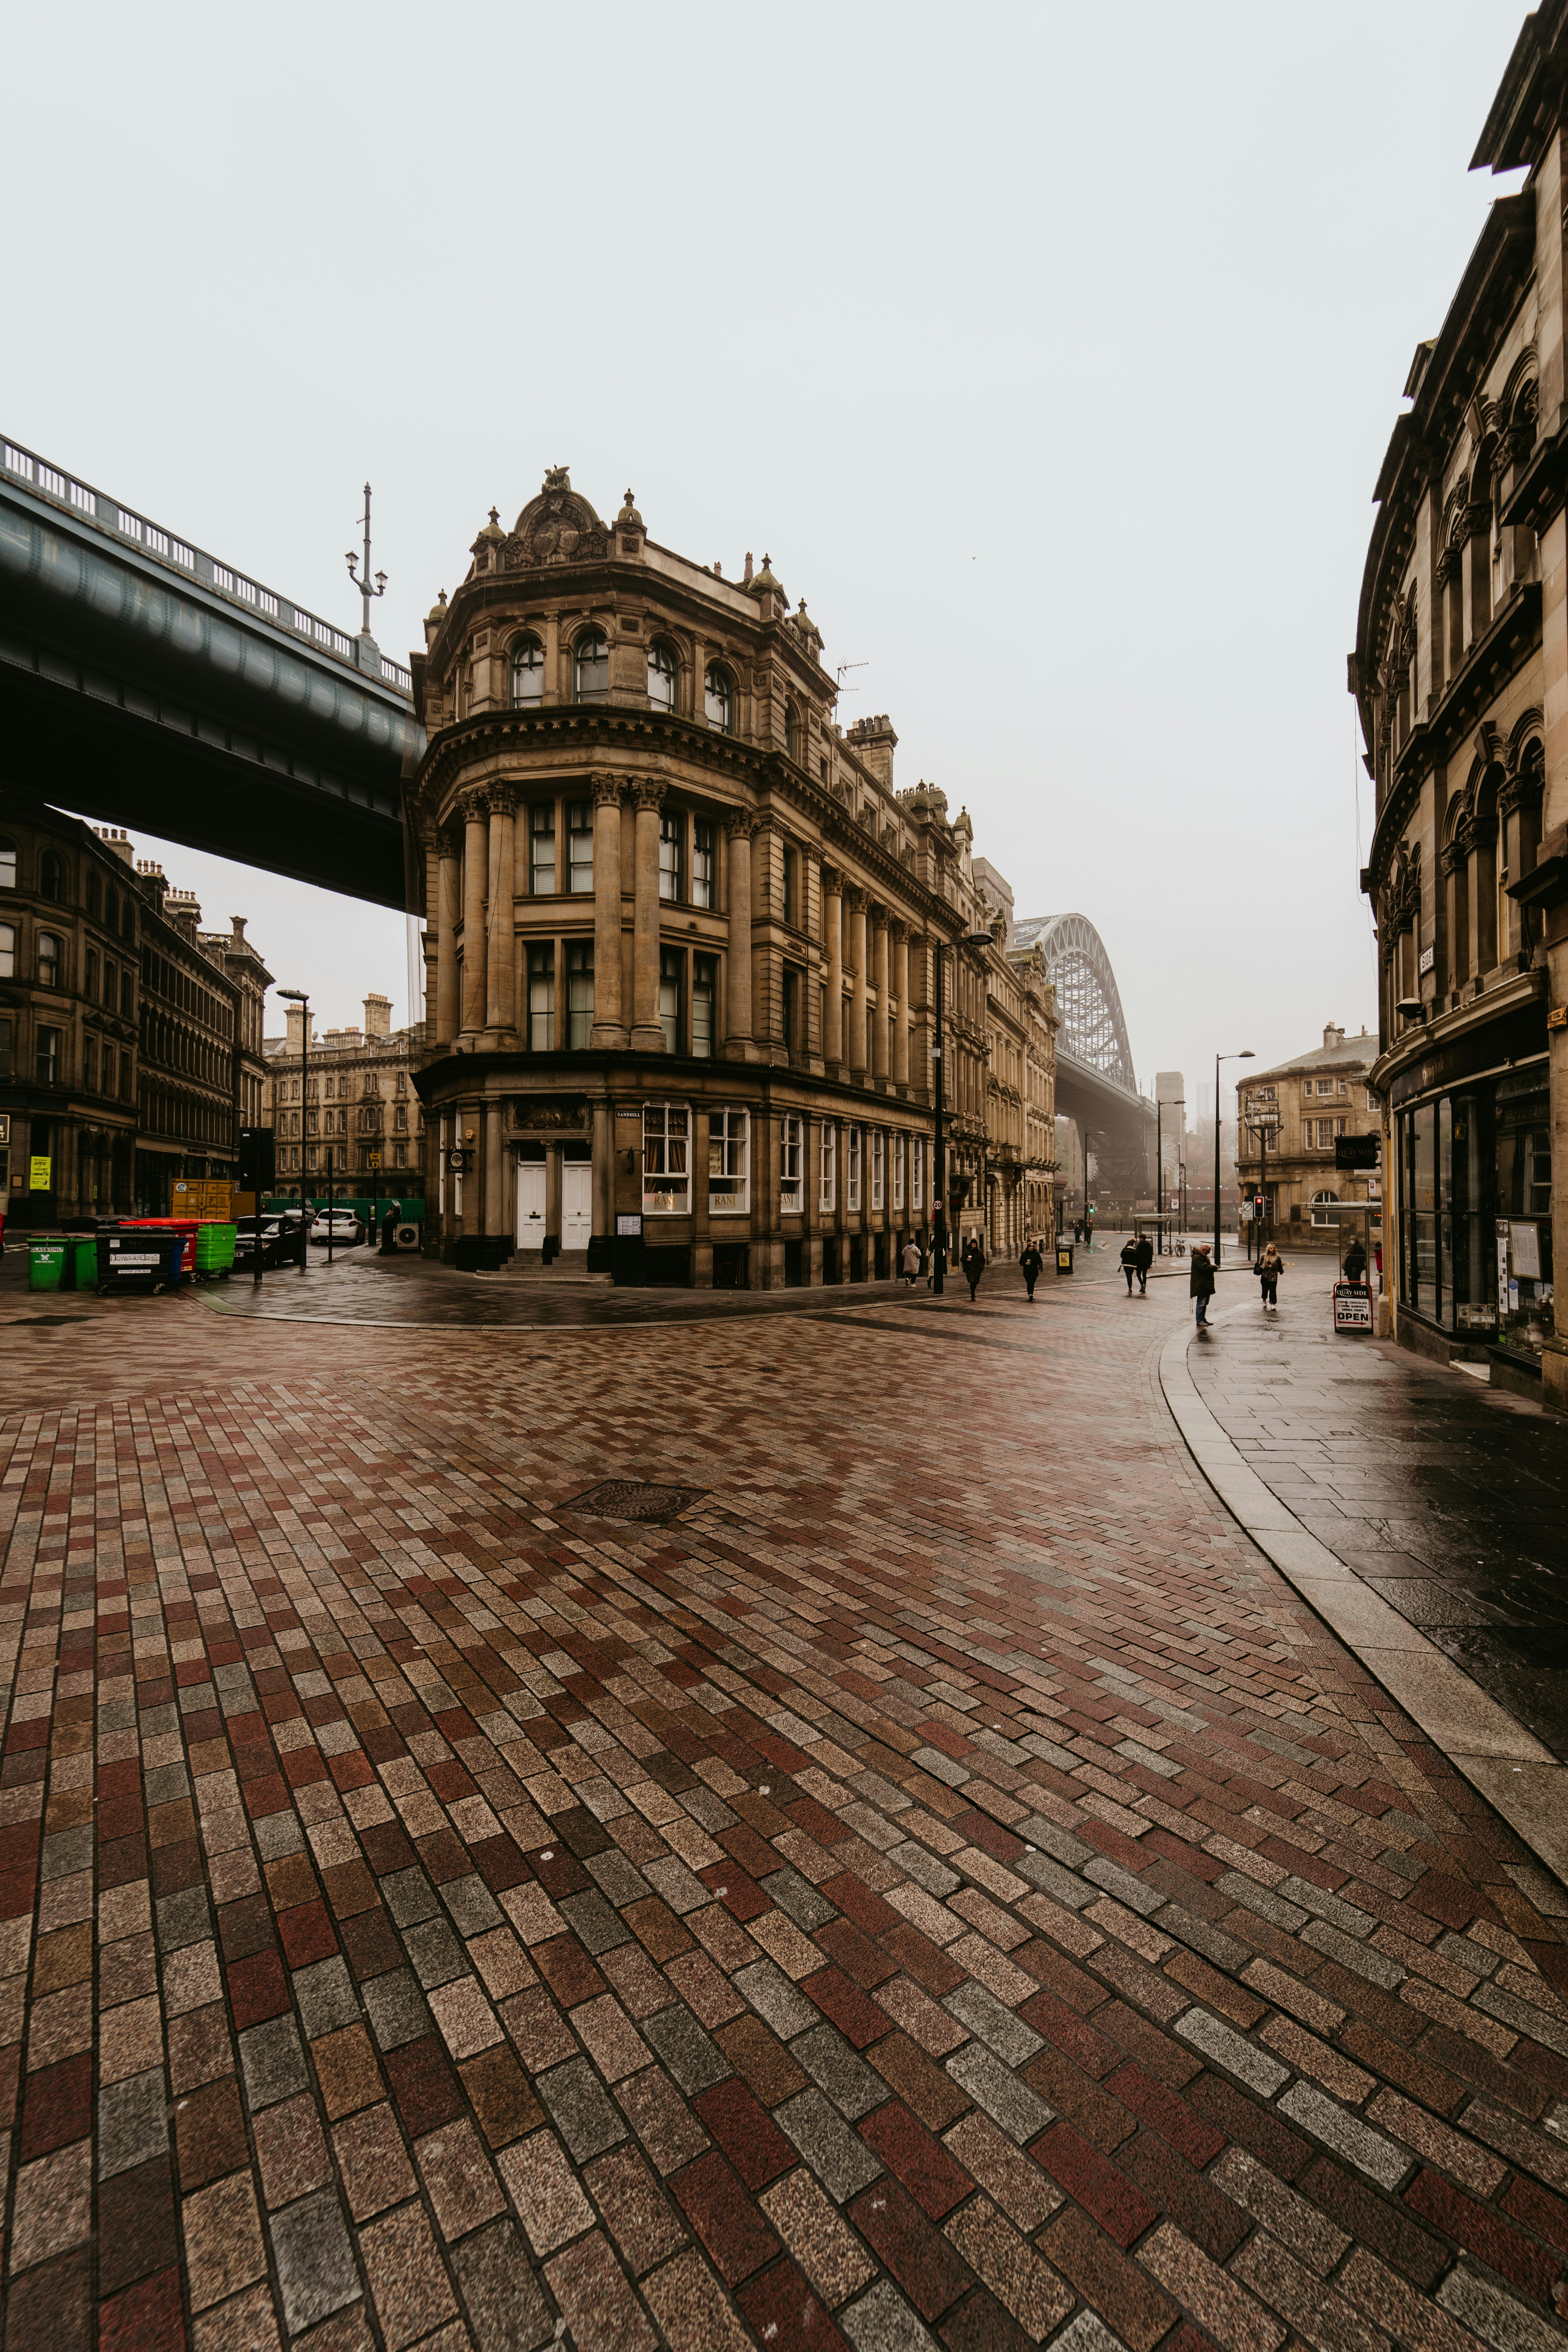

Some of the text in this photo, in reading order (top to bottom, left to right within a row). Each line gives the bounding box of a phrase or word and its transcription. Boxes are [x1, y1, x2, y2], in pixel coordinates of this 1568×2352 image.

[1422, 951, 1431, 969] SIDE
[1338, 1148, 1356, 1158] QUAY
[654, 1195, 677, 1205] RANI
[715, 1196, 736, 1205] RANI
[1337, 1289, 1352, 1297] QUAY
[1338, 1312, 1368, 1321] OPEN
